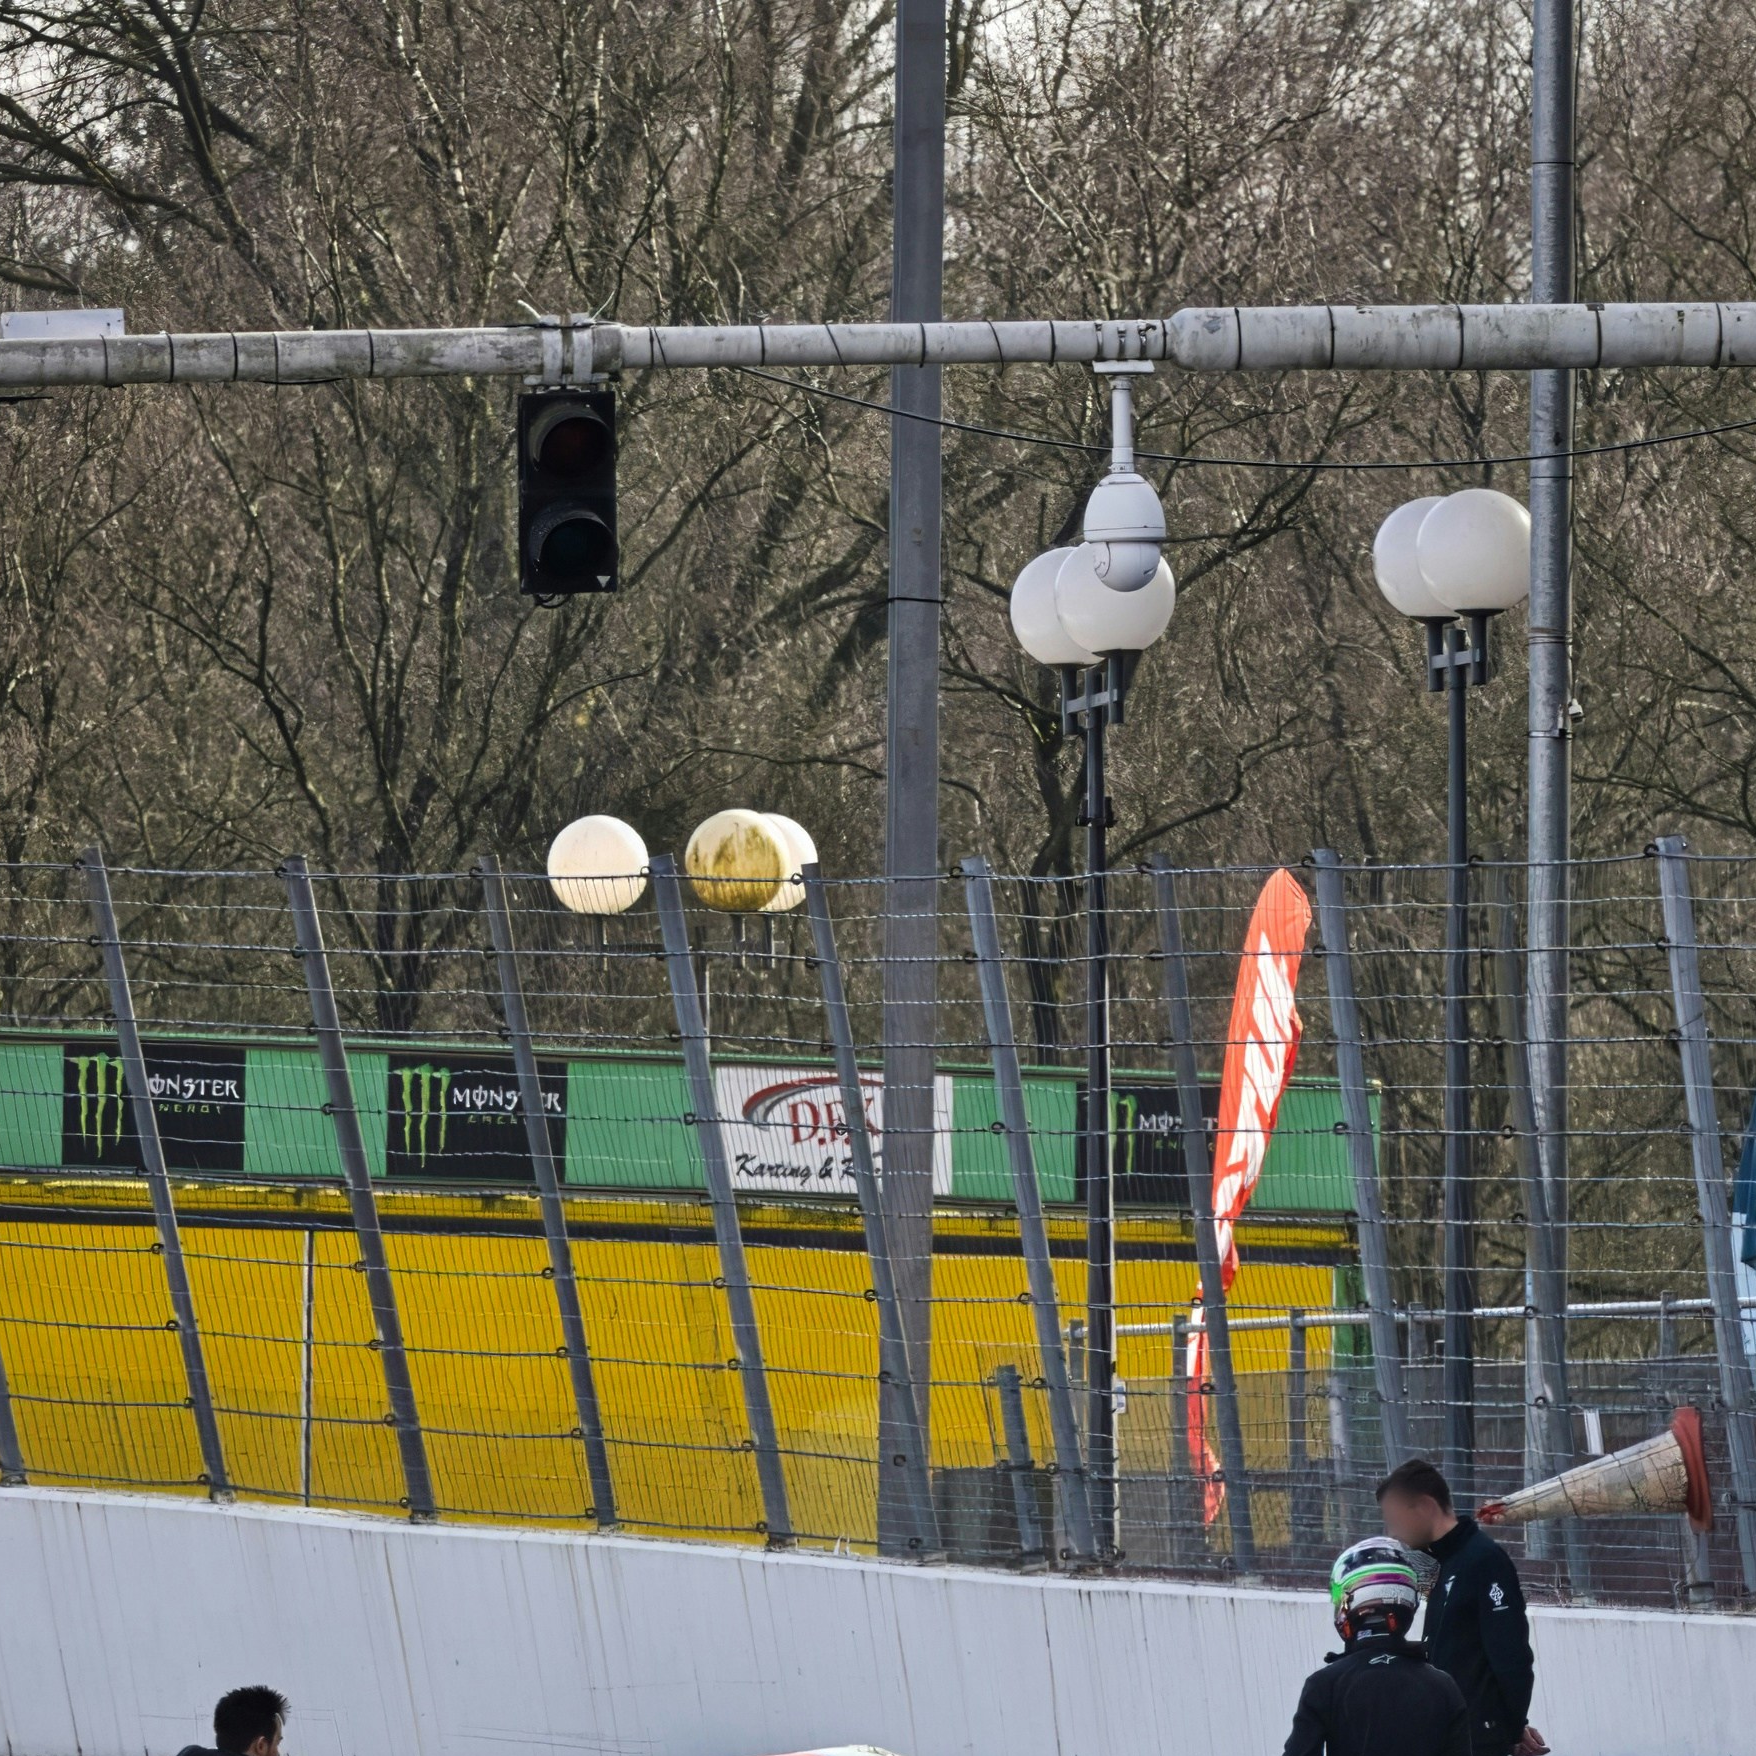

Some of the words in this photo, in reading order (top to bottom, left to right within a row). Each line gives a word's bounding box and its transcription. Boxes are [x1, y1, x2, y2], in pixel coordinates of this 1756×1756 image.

[148, 1073, 240, 1099] ONSTER
[452, 1084, 562, 1112] MONSR
[735, 1153, 812, 1186] Karting
